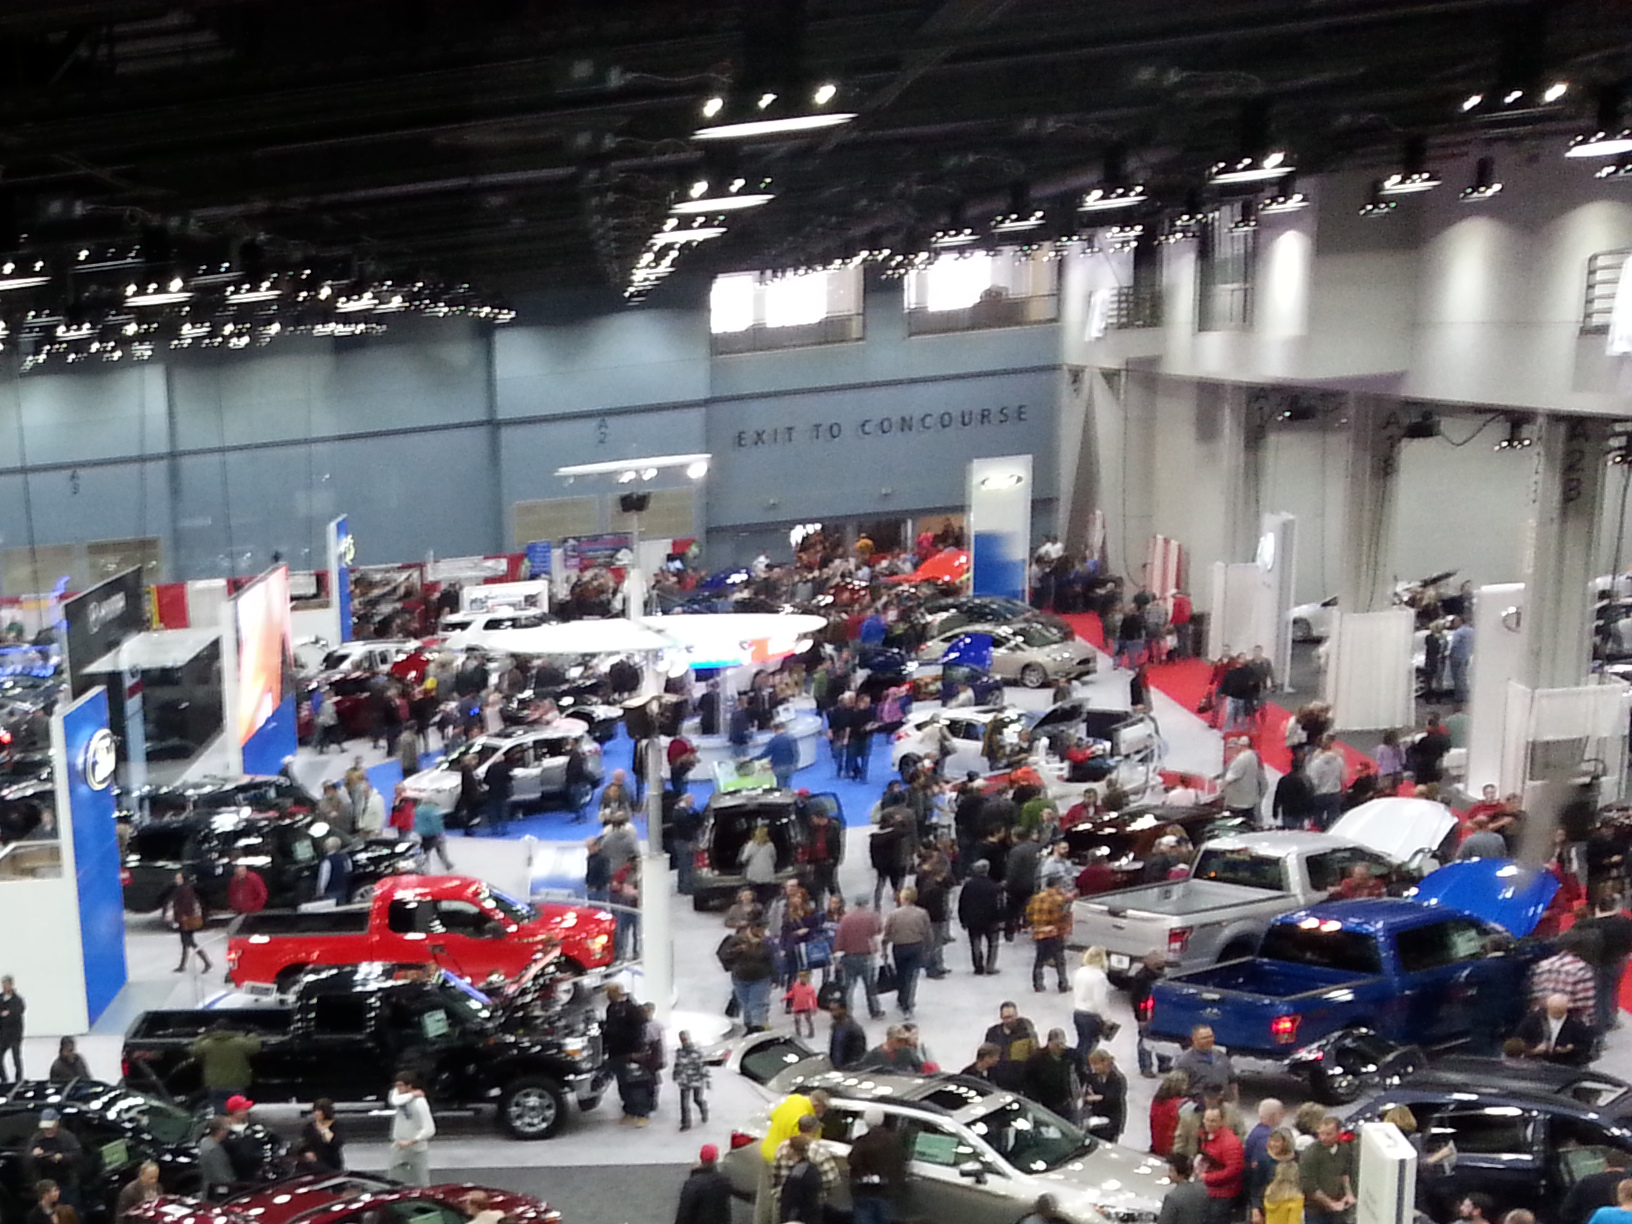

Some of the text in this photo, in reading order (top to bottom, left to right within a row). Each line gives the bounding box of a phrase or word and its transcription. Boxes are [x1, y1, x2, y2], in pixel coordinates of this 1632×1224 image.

[736, 403, 1029, 448] EXIT TO CONCOURSE
